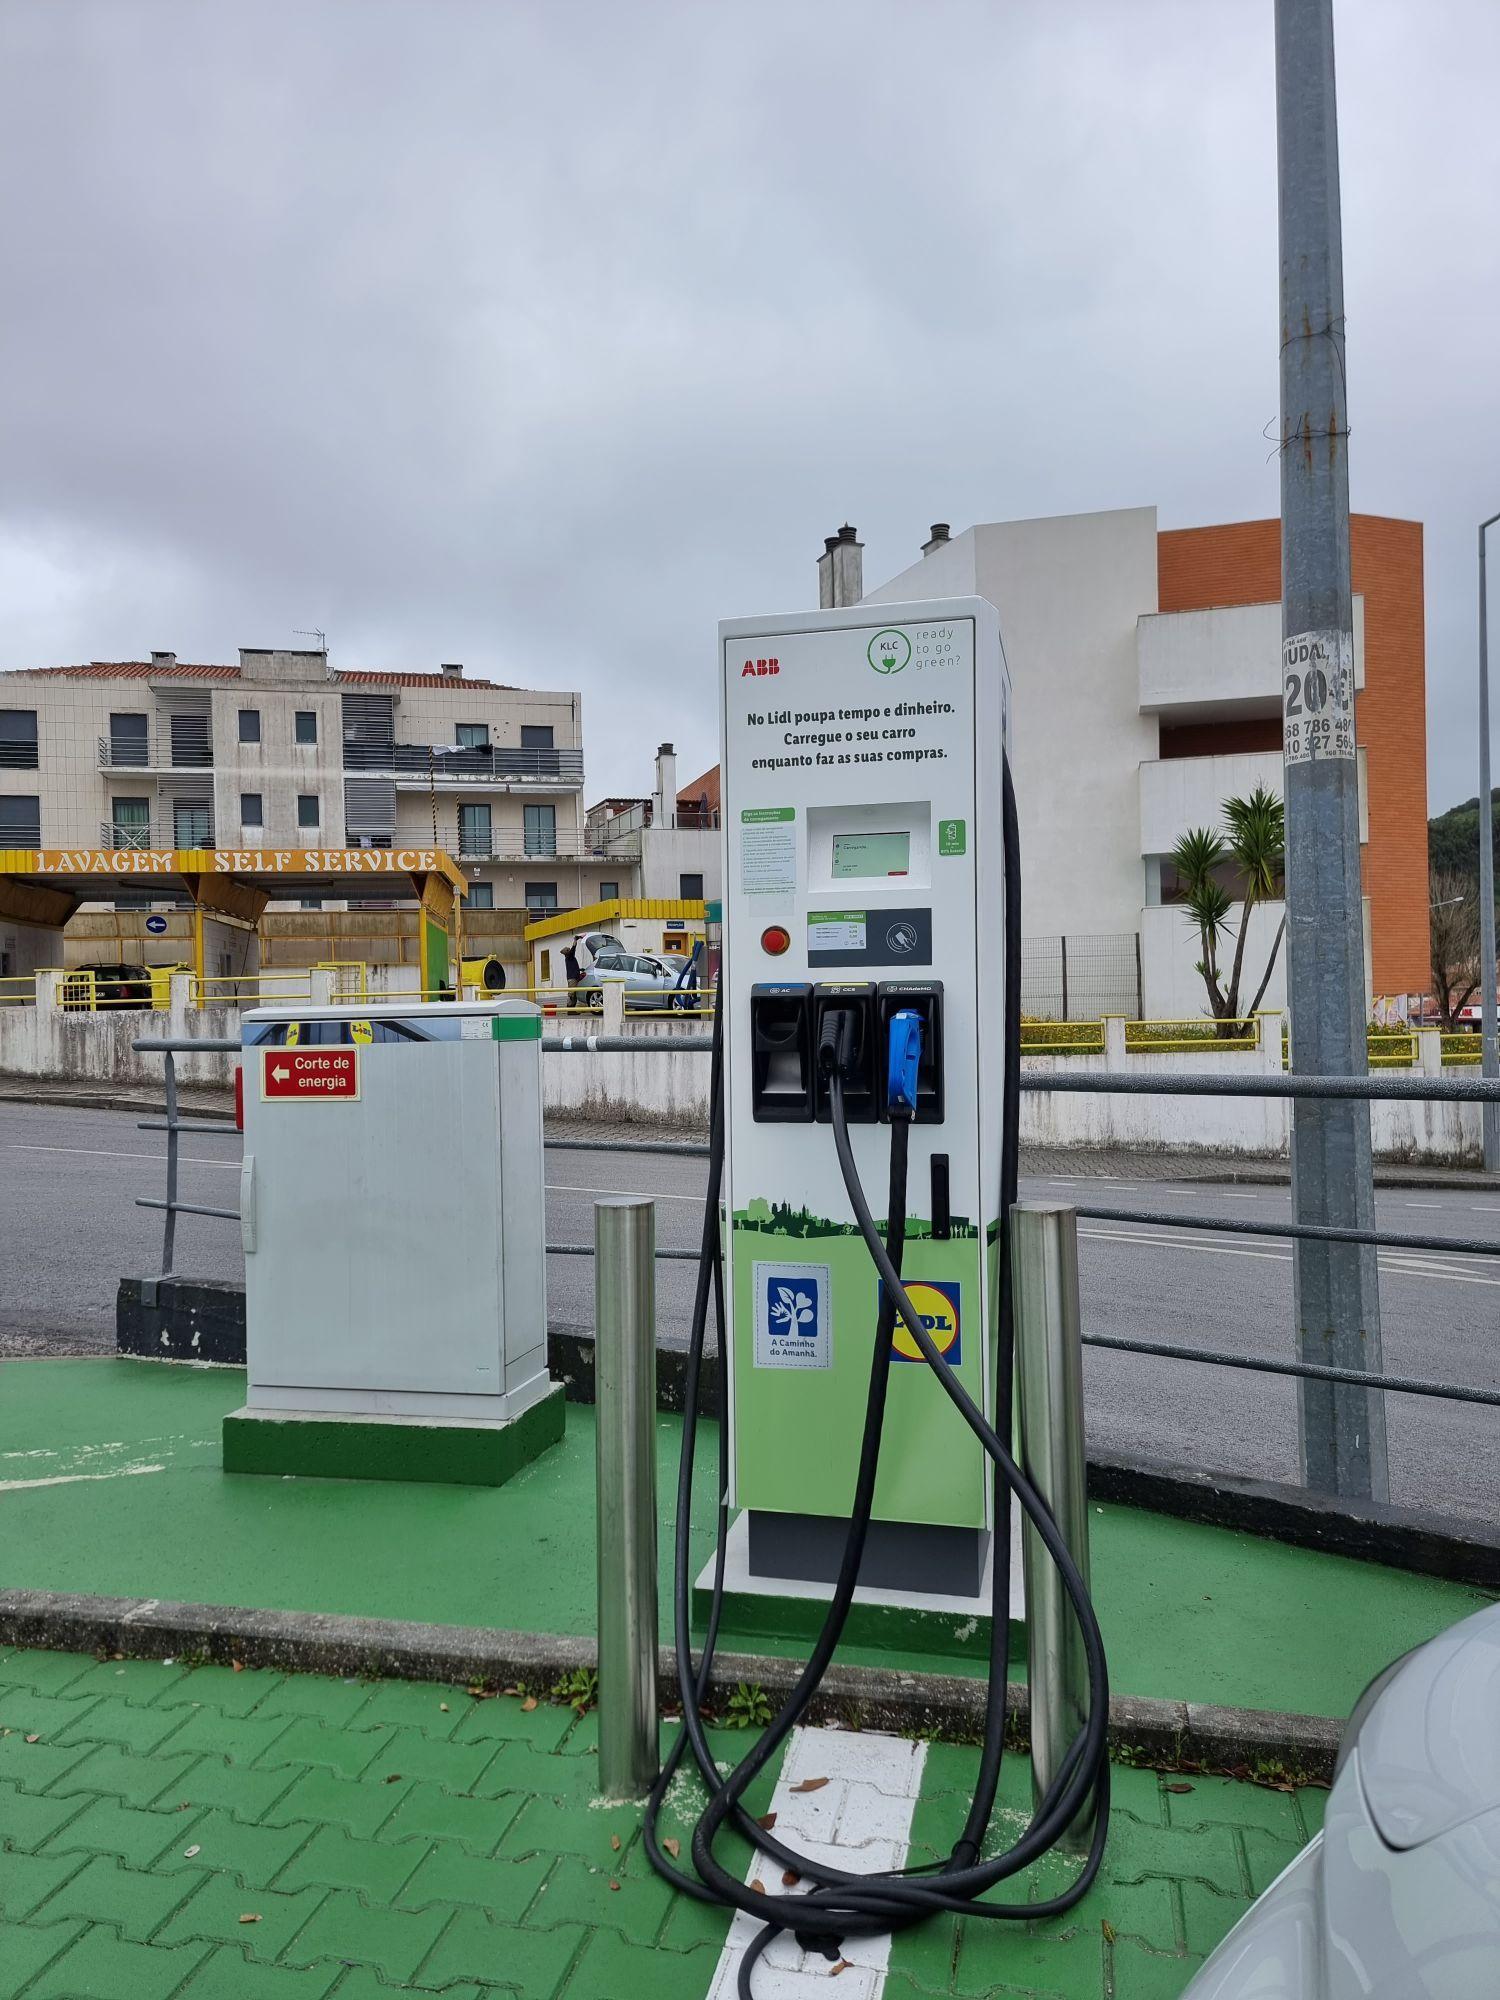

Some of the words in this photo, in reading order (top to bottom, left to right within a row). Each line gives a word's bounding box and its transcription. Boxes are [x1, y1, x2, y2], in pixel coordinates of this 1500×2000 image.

[916, 627, 954, 640] ready
[880, 640, 899, 651] KLC
[916, 643, 929, 654] to
[935, 643, 951, 656] go
[741, 658, 780, 677] ABB
[915, 655, 961, 670] green?
[747, 712, 764, 726] No
[768, 710, 791, 725] Lidl
[795, 710, 835, 727] poupa
[838, 706, 881, 722] tempo
[883, 707, 891, 717] e
[894, 701, 956, 717] dinheiro.
[1304, 718, 1330, 735] 786
[784, 731, 842, 747] Carregue
[845, 732, 853, 742] o
[856, 729, 879, 742] seu
[881, 727, 916, 739] carro
[751, 756, 813, 771] enquanto
[816, 752, 835, 765] faz
[837, 753, 851, 764] as
[853, 752, 883, 764] suas
[886, 746, 948, 764] compras.
[36, 852, 173, 873] LAVAGEM
[215, 852, 292, 873] SELF
[305, 851, 437, 872] SERVICE
[295, 1057, 330, 1069] Corte
[333, 1057, 349, 1069] de
[299, 1075, 346, 1090] energia
[771, 1339, 778, 1347] A
[779, 1338, 815, 1348] Caminho
[770, 1349, 780, 1357] do
[782, 1348, 818, 1358] Amanhã.
